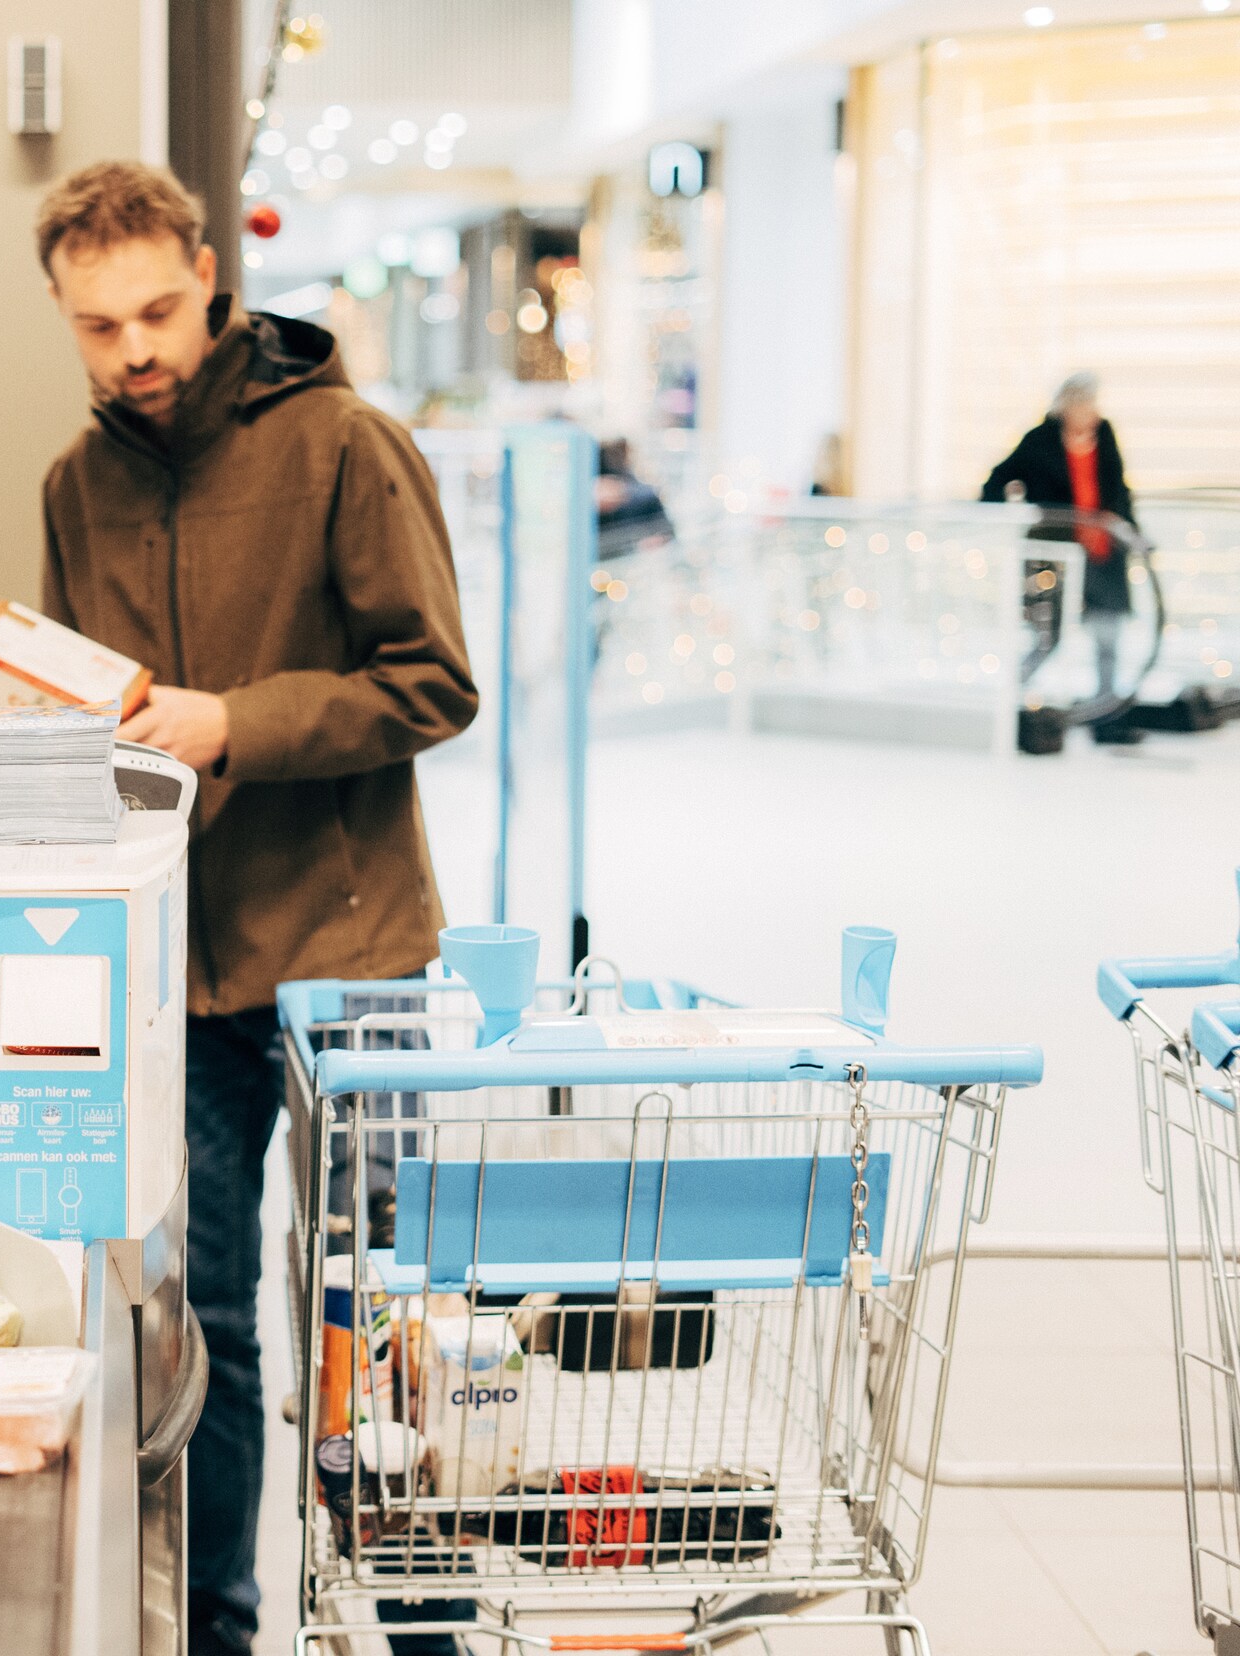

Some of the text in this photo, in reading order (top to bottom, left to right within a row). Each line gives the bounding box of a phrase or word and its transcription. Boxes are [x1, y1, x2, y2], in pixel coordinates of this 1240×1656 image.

[13, 1086, 92, 1098] Scan hier uw:
[43, 1137, 62, 1145] kaart
[93, 1137, 107, 1145] bon
[41, 1150, 63, 1162] kan
[66, 1150, 88, 1162] ook
[91, 1151, 117, 1163] met:
[59, 1227, 83, 1235] Smart-
[451, 1381, 518, 1410] alpro
